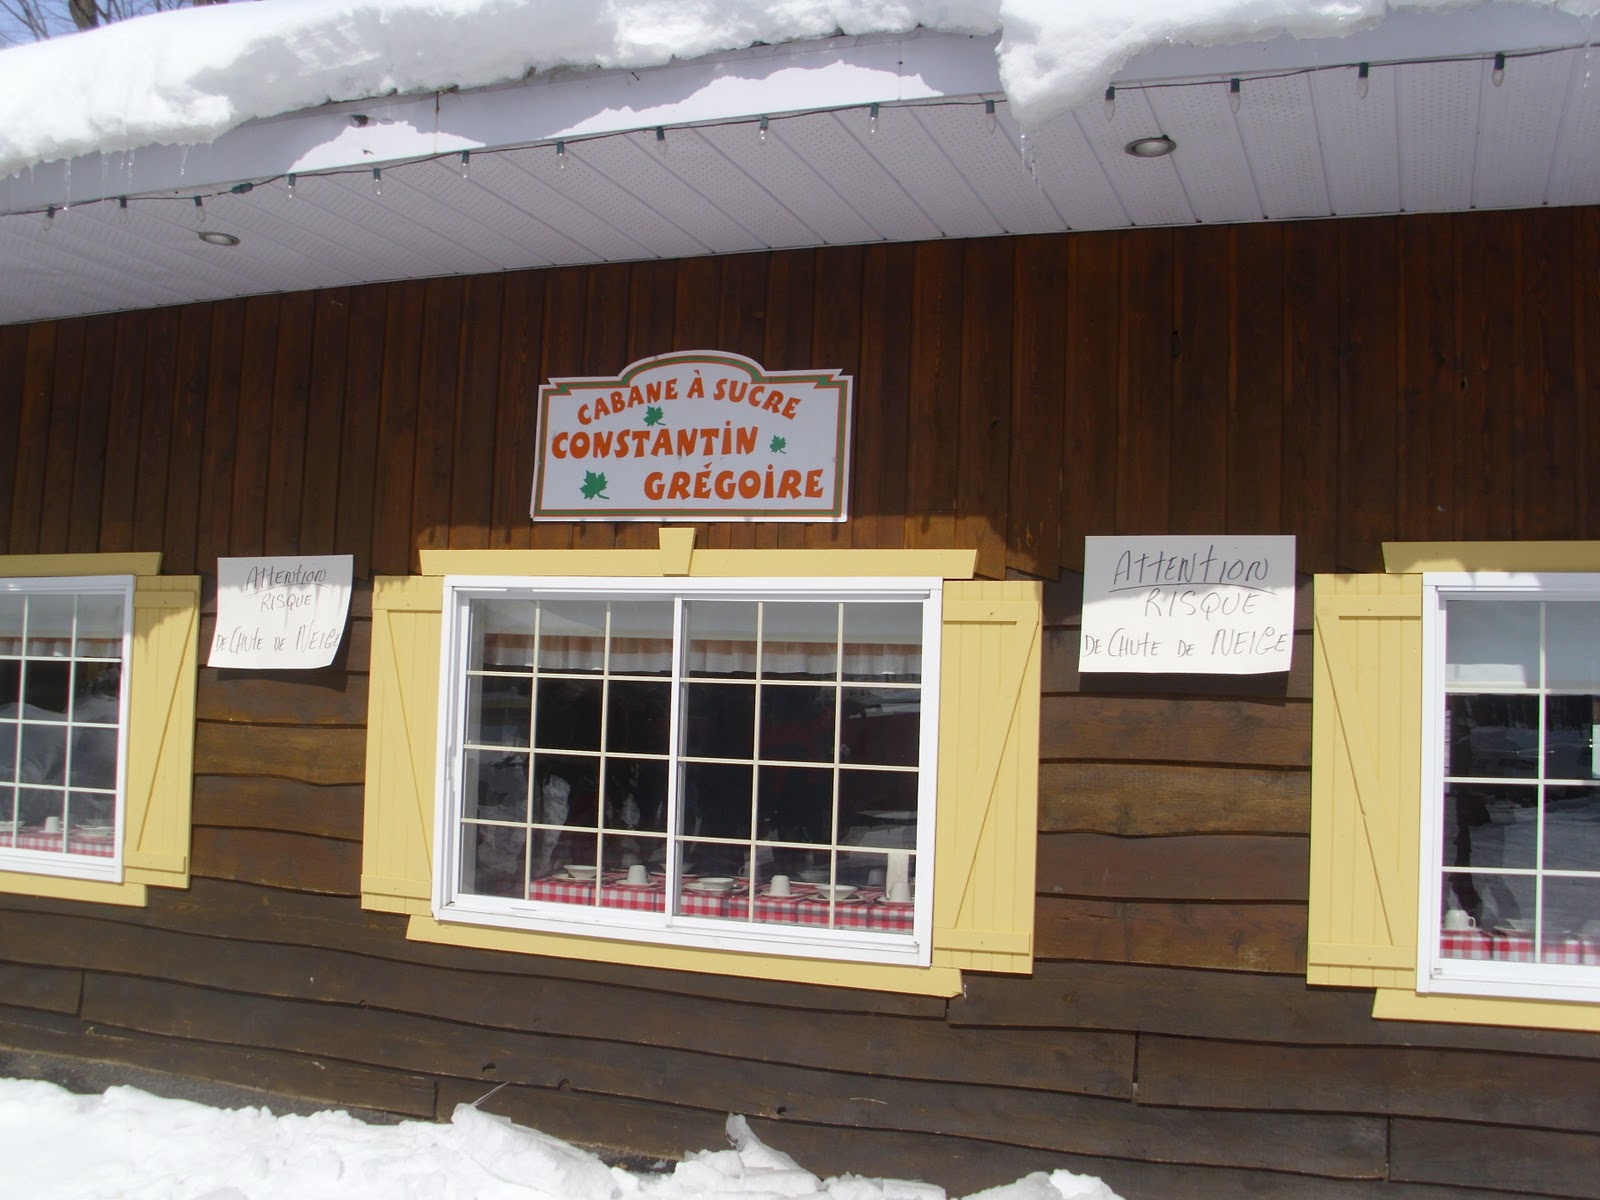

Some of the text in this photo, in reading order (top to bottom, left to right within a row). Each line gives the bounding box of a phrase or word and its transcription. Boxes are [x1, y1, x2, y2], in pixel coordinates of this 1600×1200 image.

[577, 369, 802, 425] CABANE À SUCRE
[551, 420, 759, 459] CONSTANTIN
[643, 462, 824, 501] GRÉGOIRE
[260, 593, 312, 612] RISQUE
[1144, 588, 1261, 620] RISQUE
[215, 634, 228, 652] DE
[273, 636, 287, 653] DE
[1083, 634, 1102, 657] DE
[1177, 639, 1196, 658] DE
[1211, 626, 1291, 657] NEIGE
